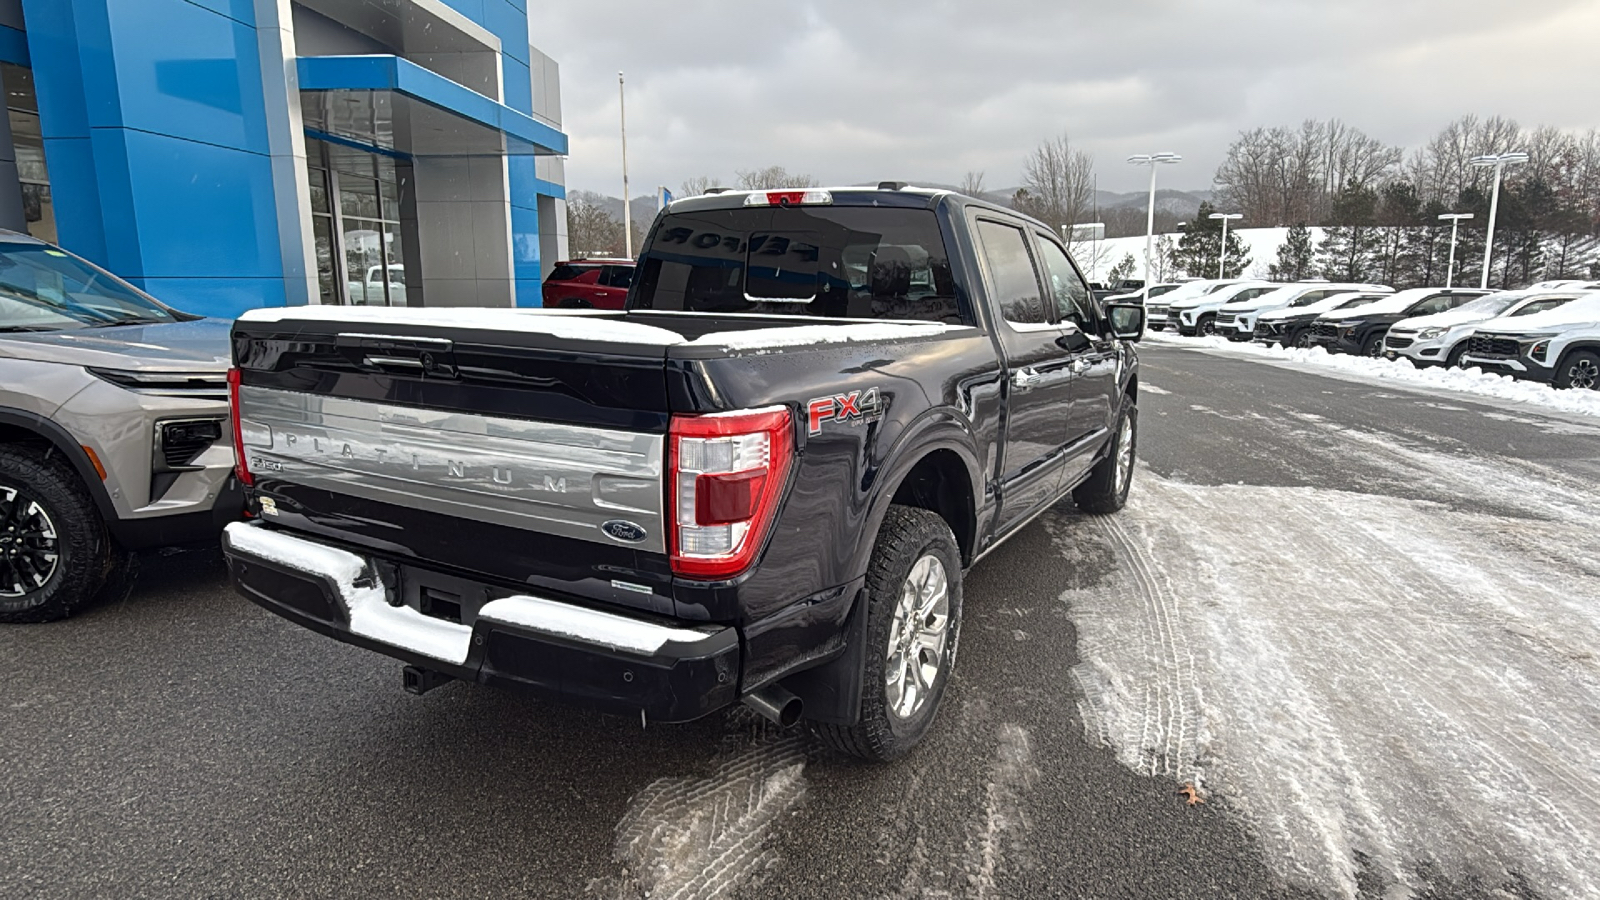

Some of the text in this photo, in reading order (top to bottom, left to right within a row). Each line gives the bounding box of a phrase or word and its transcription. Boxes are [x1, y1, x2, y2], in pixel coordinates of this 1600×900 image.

[807, 387, 882, 437] FX4
[287, 433, 567, 494] PLATINUM
[611, 523, 636, 539] Ford
